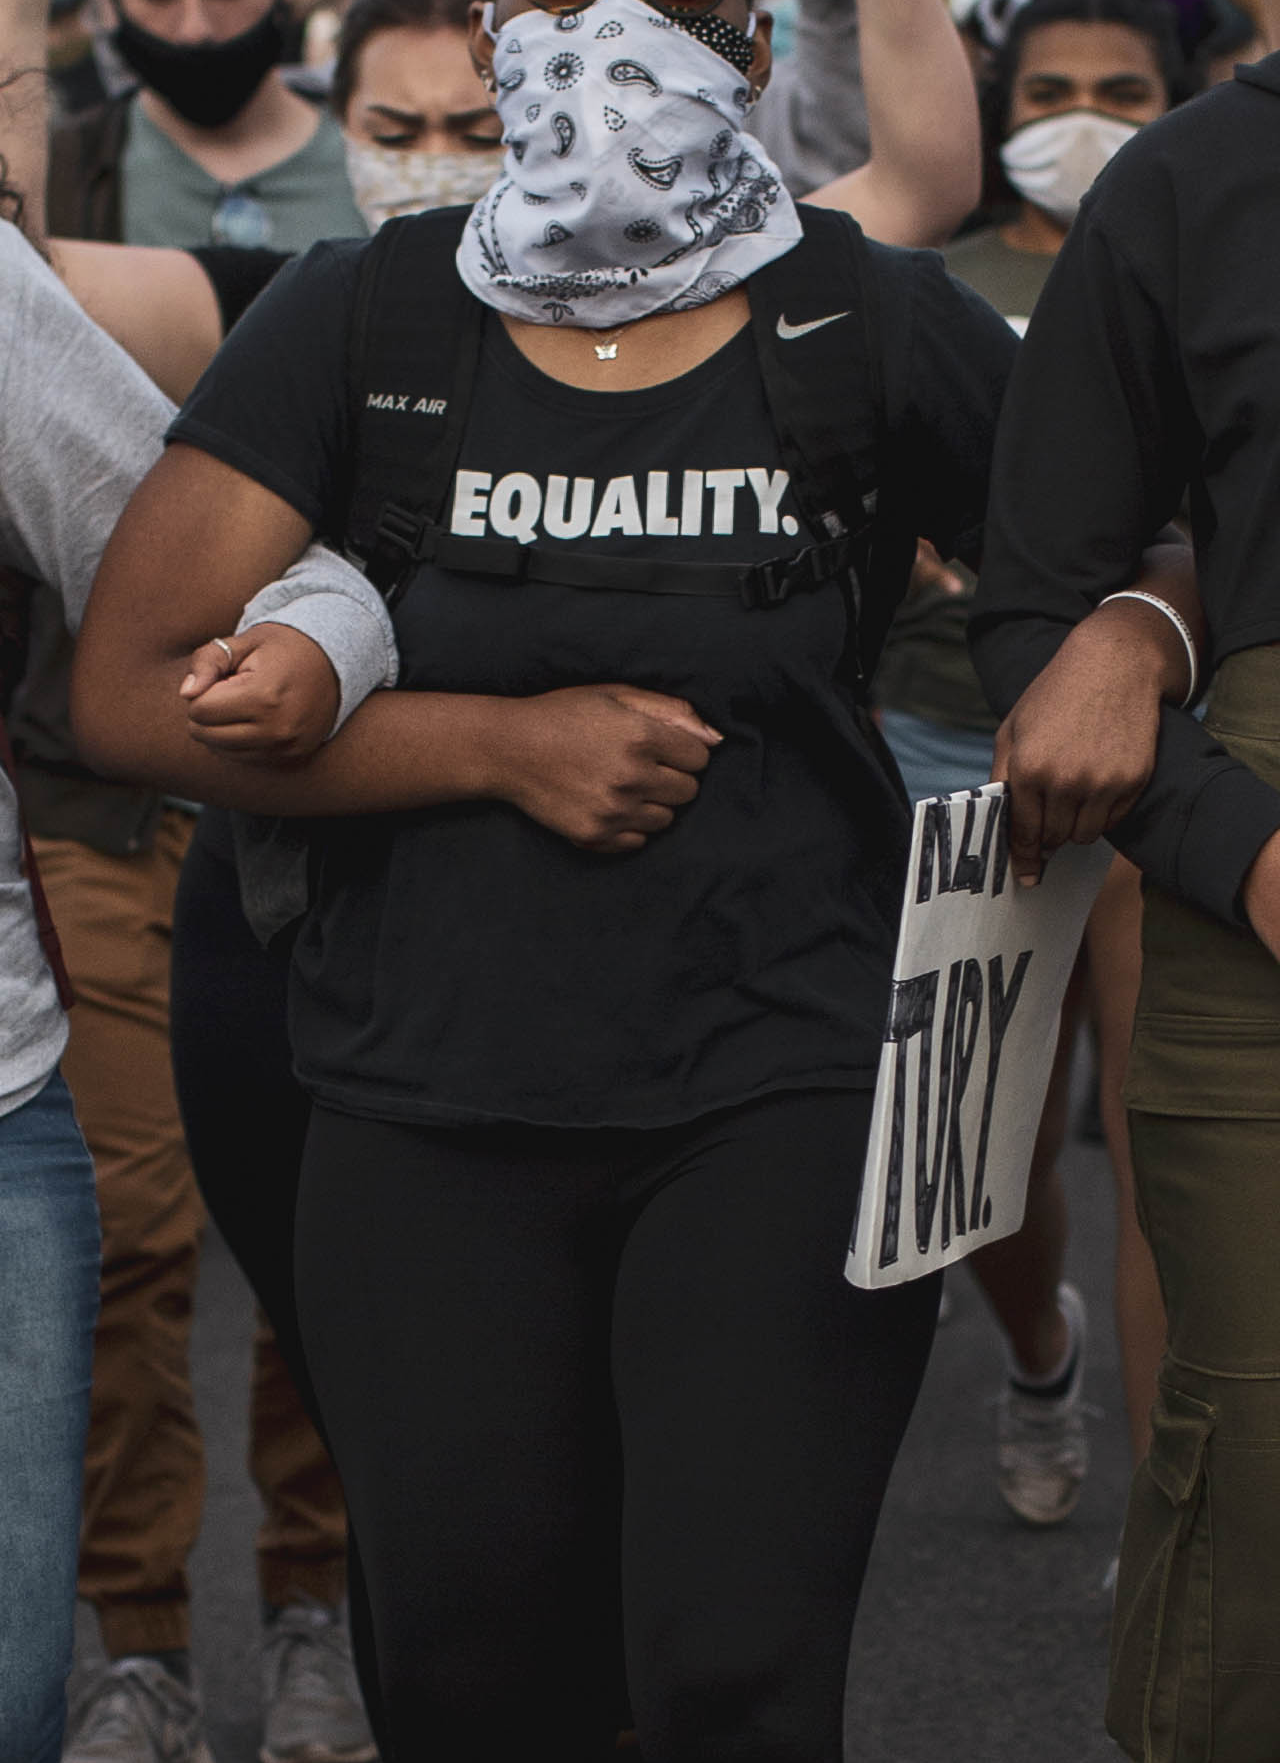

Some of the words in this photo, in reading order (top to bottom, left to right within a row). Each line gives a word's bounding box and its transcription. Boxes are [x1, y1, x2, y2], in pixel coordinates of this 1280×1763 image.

[366, 393, 409, 411] MAX
[412, 397, 448, 415] AIR
[450, 468, 799, 544] EQUALITY.
